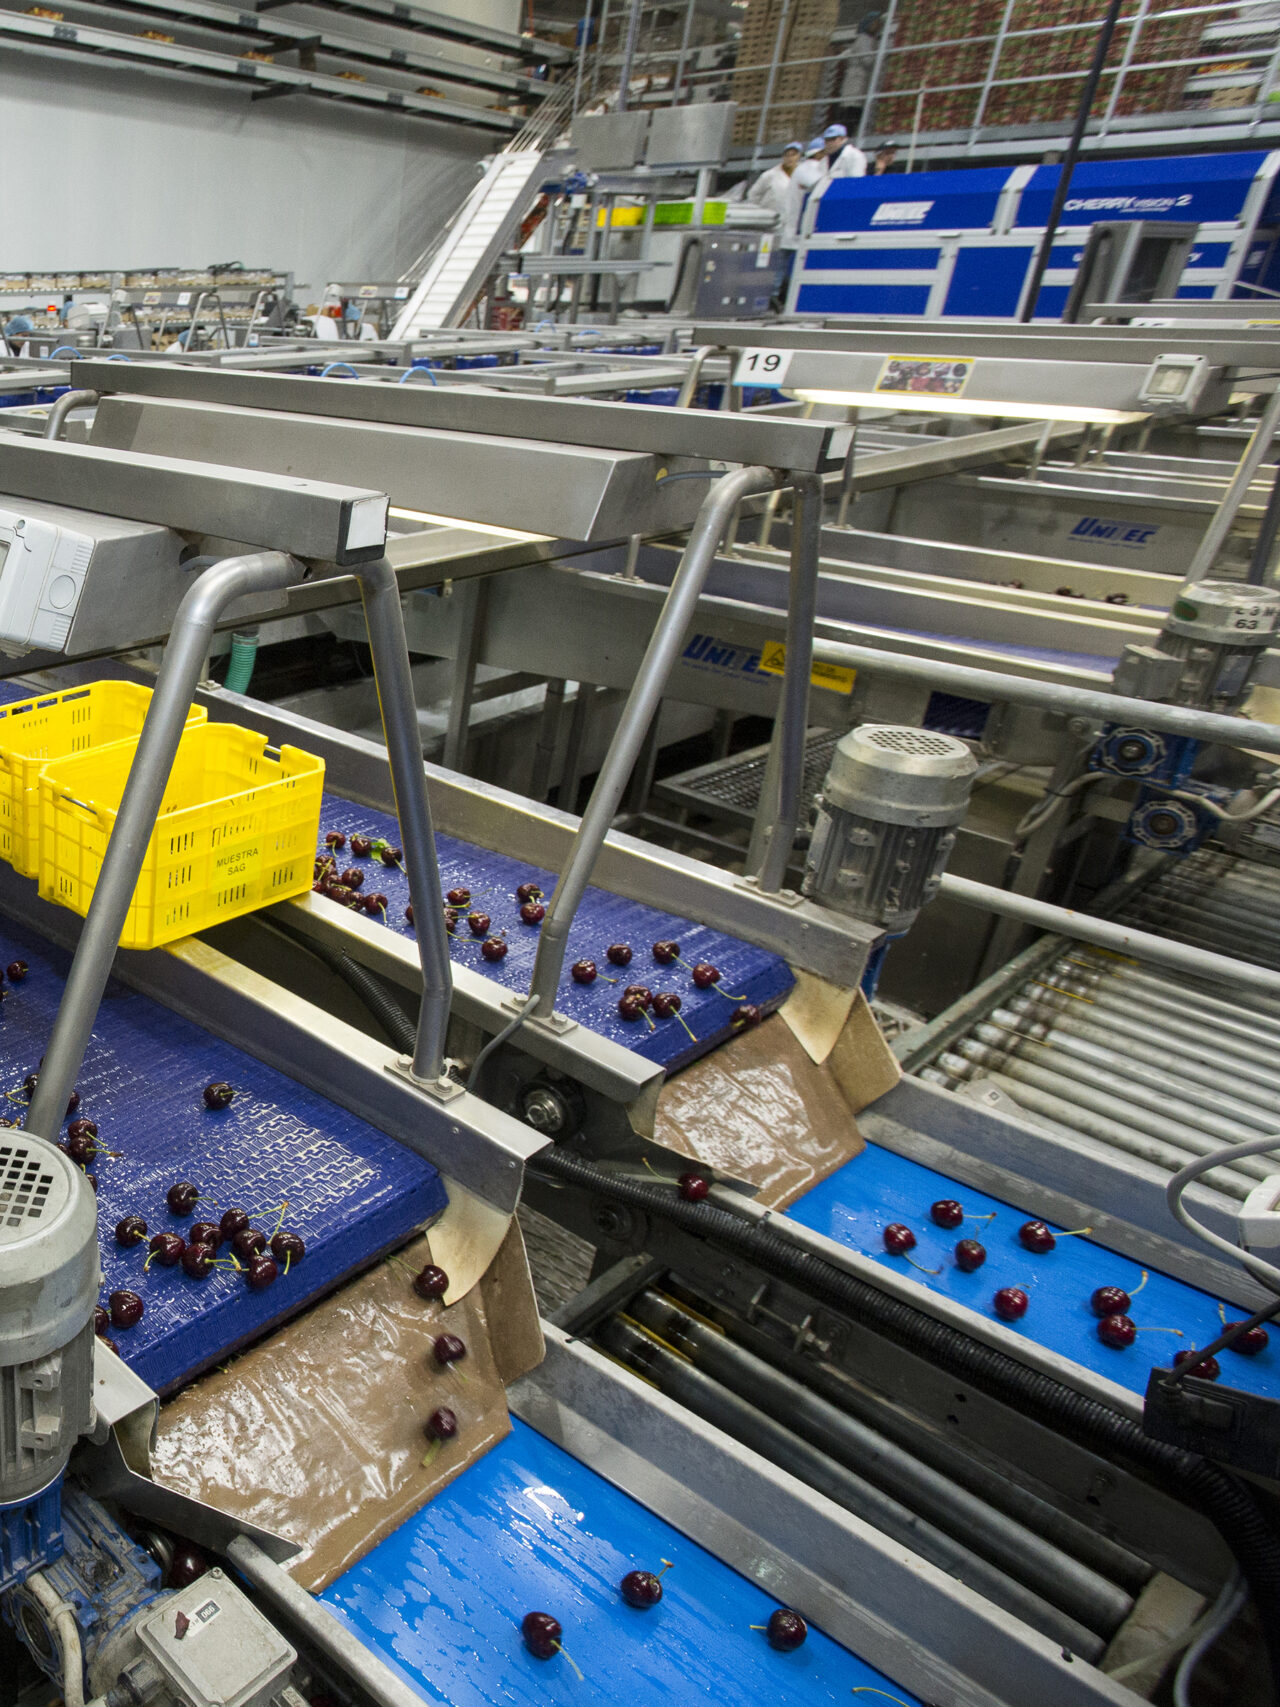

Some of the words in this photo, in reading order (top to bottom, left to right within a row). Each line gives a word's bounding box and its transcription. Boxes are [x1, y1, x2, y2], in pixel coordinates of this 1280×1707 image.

[1063, 196, 1138, 211] CHERRY
[1175, 194, 1193, 206] 2
[747, 353, 782, 372] 19
[1070, 517, 1161, 543] UNITEC
[1235, 619, 1259, 630] 63
[682, 633, 771, 677] UNITE
[216, 847, 259, 868] MUESTRA
[227, 863, 246, 876] SAG
